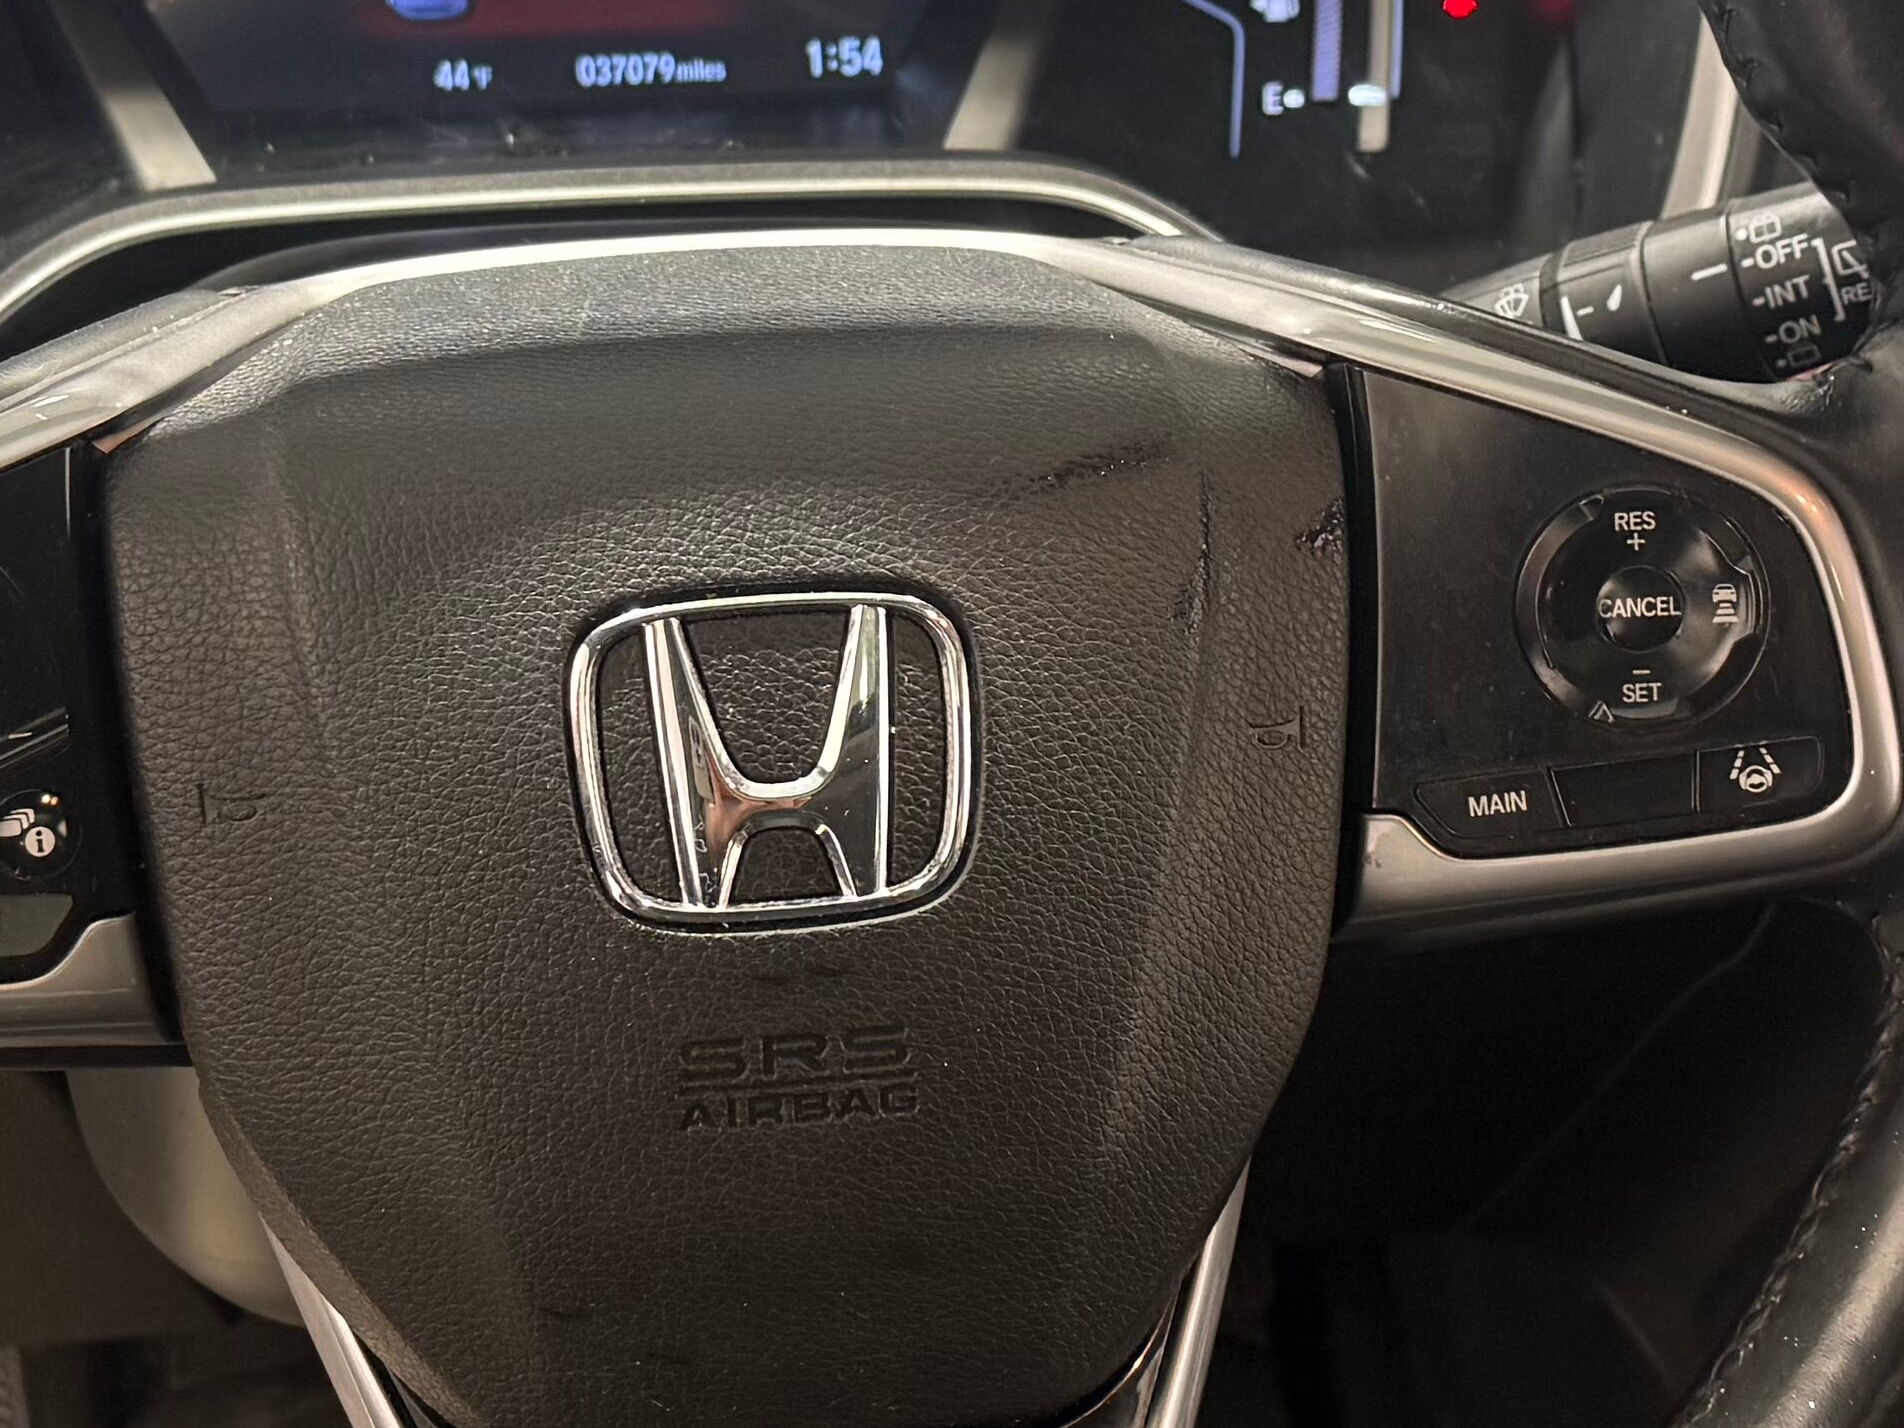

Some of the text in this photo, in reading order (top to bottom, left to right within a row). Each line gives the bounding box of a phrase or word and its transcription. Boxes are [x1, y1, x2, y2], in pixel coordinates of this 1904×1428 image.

[805, 35, 883, 79] 1:54
[1262, 79, 1285, 116] E
[1755, 232, 1810, 270] OFF
[1764, 273, 1810, 309] INT
[1778, 314, 1822, 345] ON
[1613, 510, 1657, 533] RES
[1598, 595, 1682, 619] CANCEL
[1621, 681, 1663, 705] SET
[1467, 789, 1528, 818] MAIN
[679, 1025, 913, 1082] SRS
[676, 1086, 920, 1132] AIRBAG
